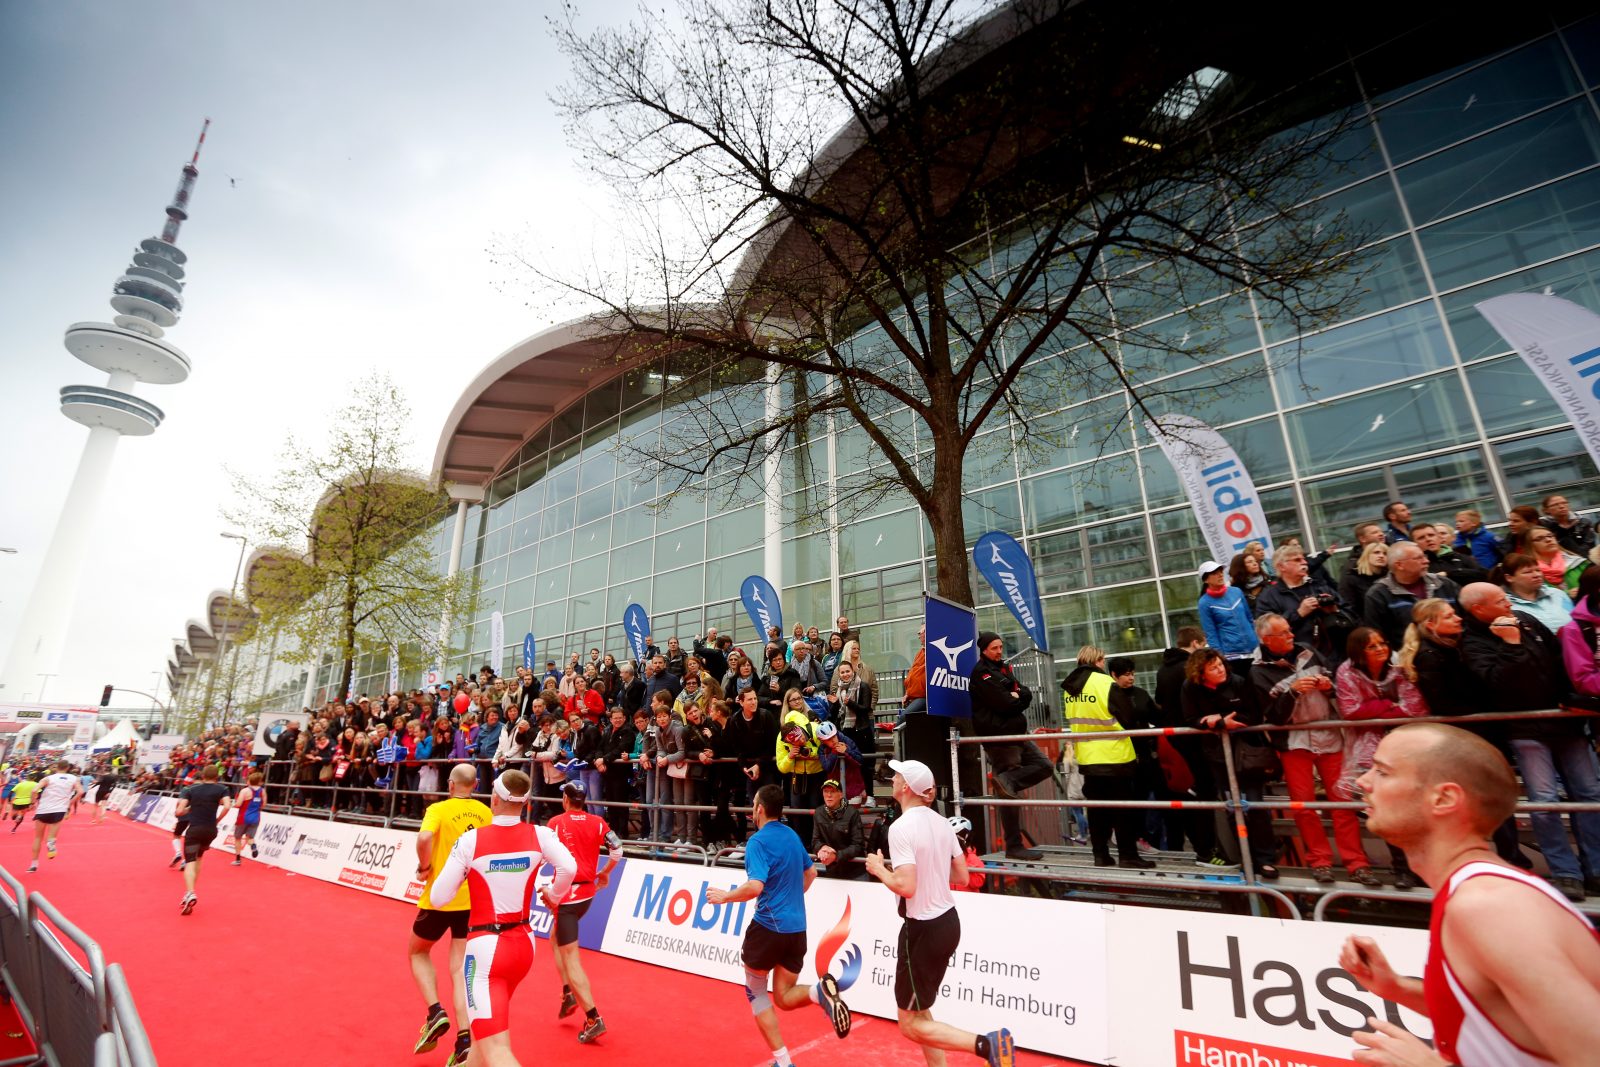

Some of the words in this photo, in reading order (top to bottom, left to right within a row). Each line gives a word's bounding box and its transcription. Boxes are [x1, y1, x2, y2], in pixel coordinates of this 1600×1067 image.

[929, 666, 971, 692] MIZUN
[348, 832, 396, 871] Haspa
[490, 861, 528, 872] Reformhaus
[633, 873, 747, 937] Mobil
[963, 952, 1041, 981] Flamme
[872, 967, 893, 987] für
[958, 981, 974, 1001] in
[981, 986, 1077, 1026] Hamburg
